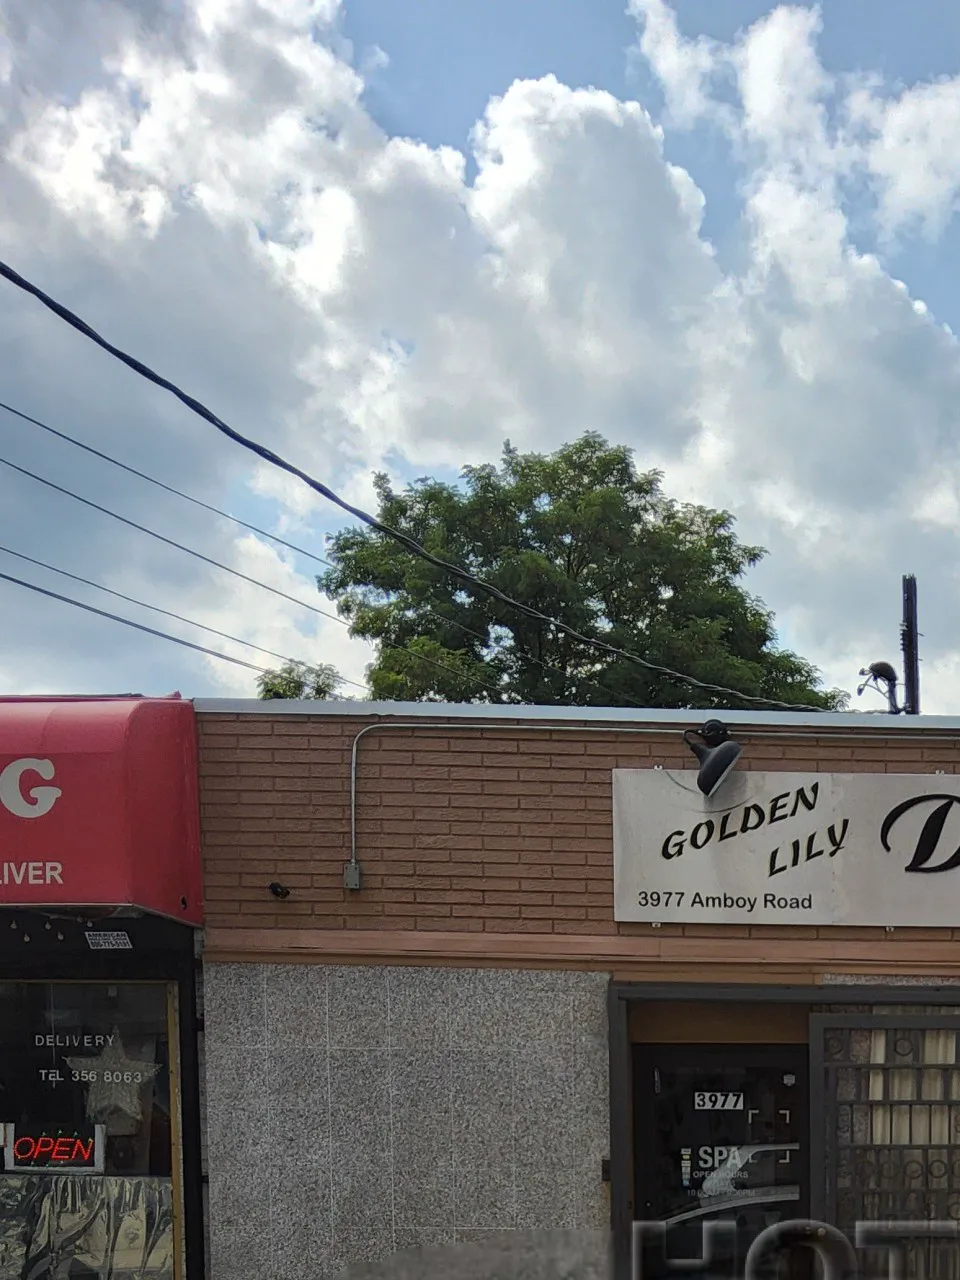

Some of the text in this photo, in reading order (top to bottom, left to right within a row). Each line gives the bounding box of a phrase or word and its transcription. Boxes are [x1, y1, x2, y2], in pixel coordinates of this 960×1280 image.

[661, 781, 819, 860] GOLDEN
[768, 818, 850, 877] LILY
[0, 862, 64, 885] IVER
[638, 891, 812, 912] 3977 Amboy Road
[35, 1034, 115, 1047] DELIVERY
[39, 1070, 142, 1083] TEL 356 8063
[696, 1093, 742, 1108] 3977
[13, 1137, 94, 1161] OPEN
[698, 1146, 742, 1169] SPA
[692, 1171, 716, 1179] OPEN
